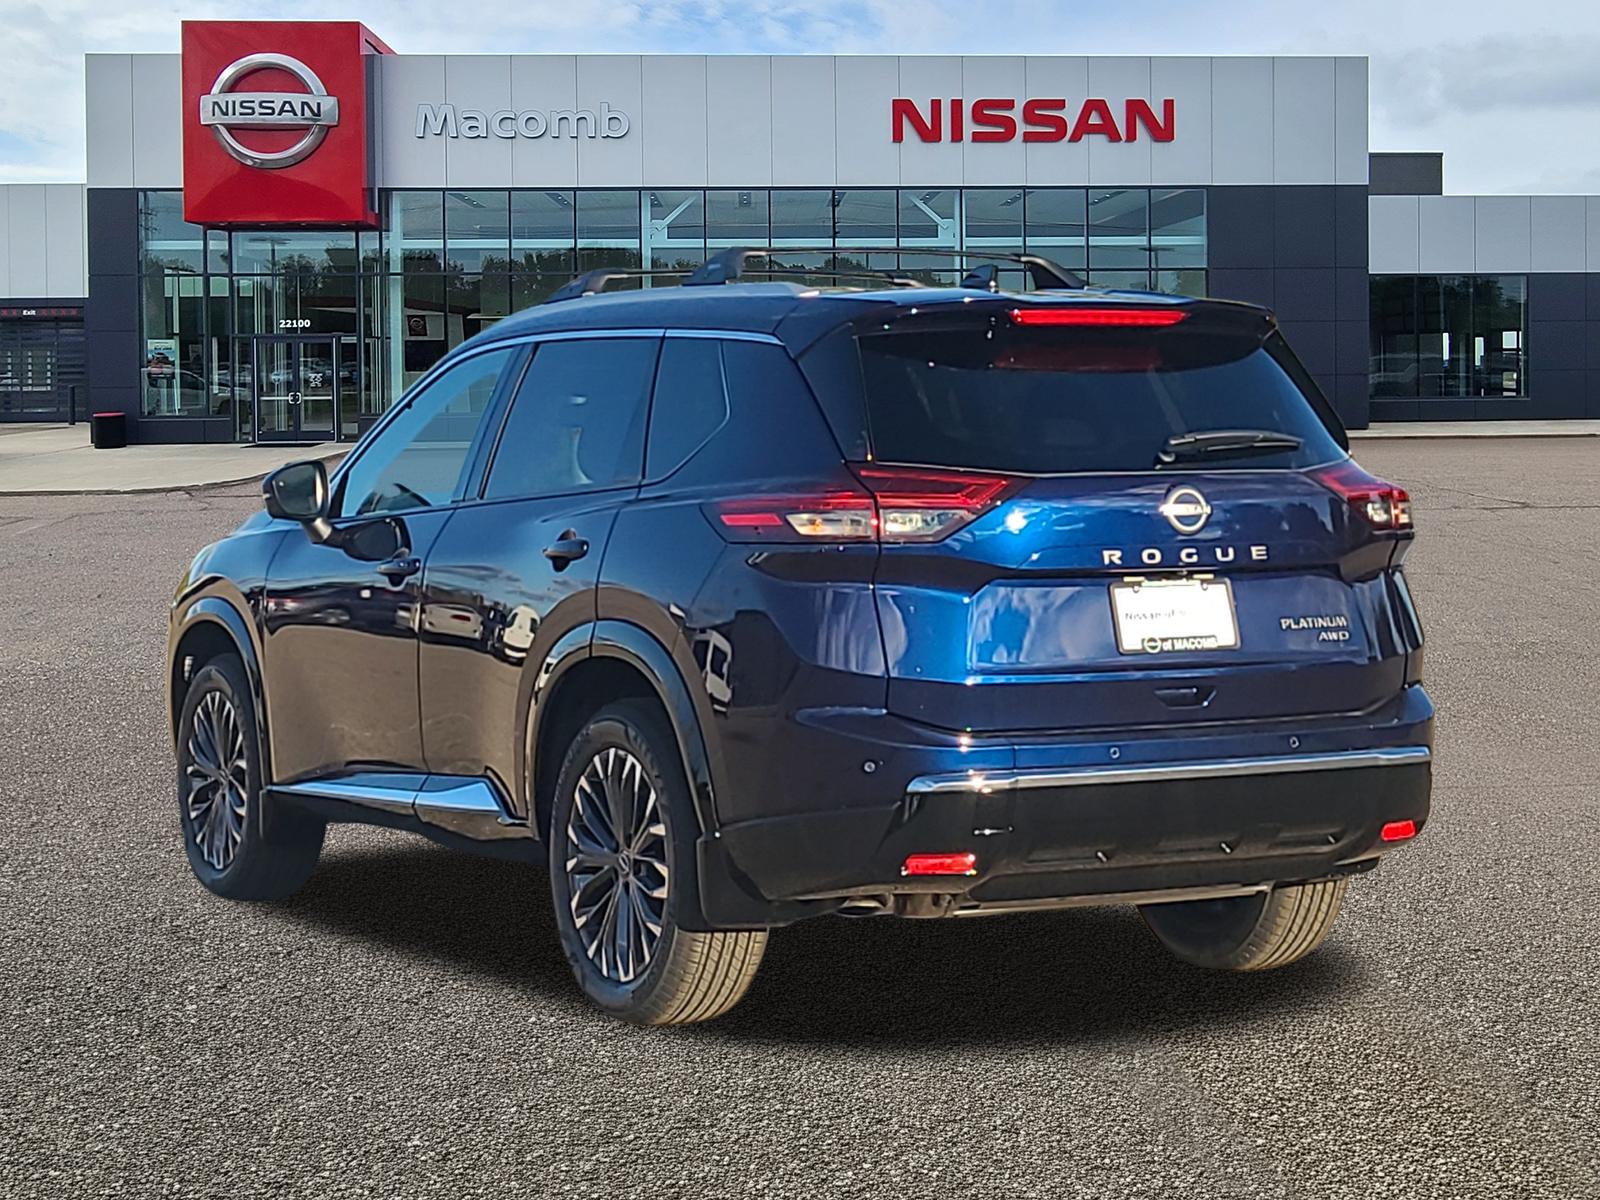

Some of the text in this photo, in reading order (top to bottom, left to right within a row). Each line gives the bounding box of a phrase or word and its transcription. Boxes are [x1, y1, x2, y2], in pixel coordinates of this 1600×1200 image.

[211, 100, 322, 118] NISSAN
[415, 101, 630, 139] Macomb
[892, 98, 1176, 143] NISSAN
[279, 319, 311, 328] 22100
[1102, 545, 1269, 565] ROGUE
[1280, 616, 1347, 630] PLATINUM
[1318, 631, 1350, 641] AWD
